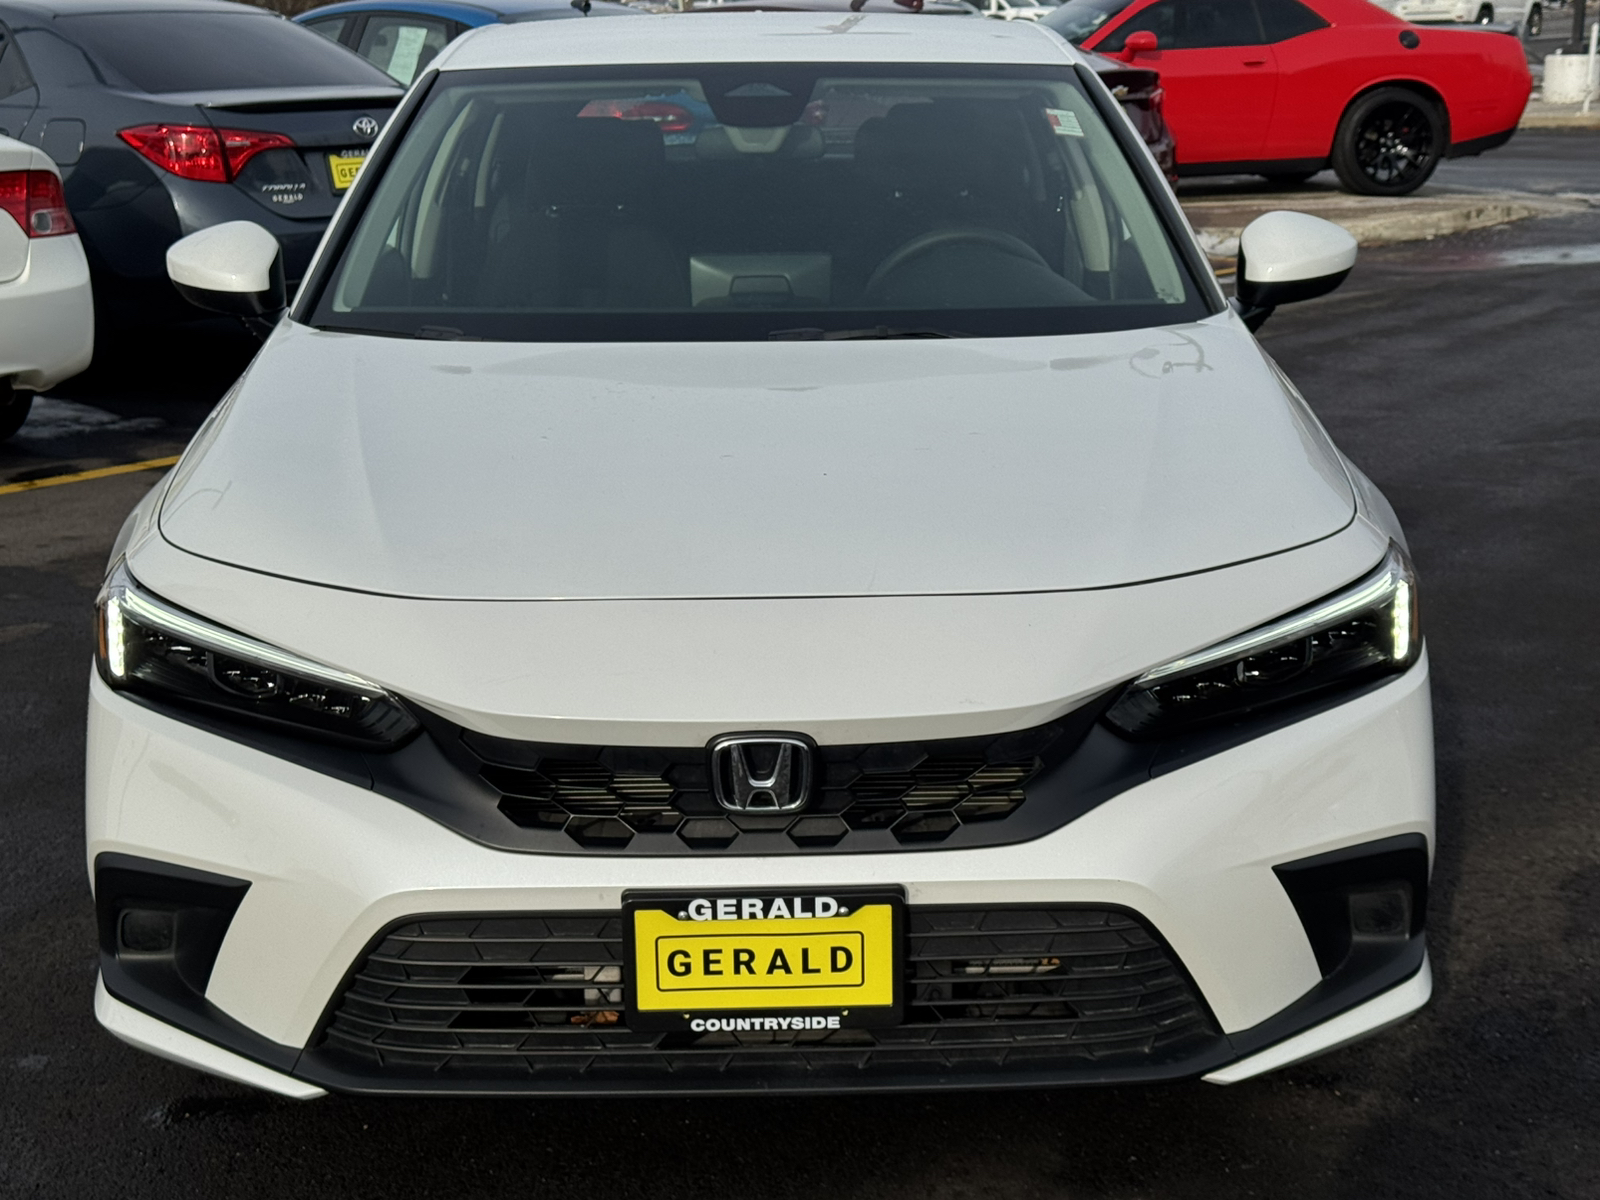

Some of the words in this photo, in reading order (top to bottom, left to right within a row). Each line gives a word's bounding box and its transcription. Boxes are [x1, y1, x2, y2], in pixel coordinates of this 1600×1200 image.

[688, 896, 838, 922] GERALD
[666, 946, 854, 977] GERALD
[690, 1016, 841, 1032] COUNTRYSIDE
